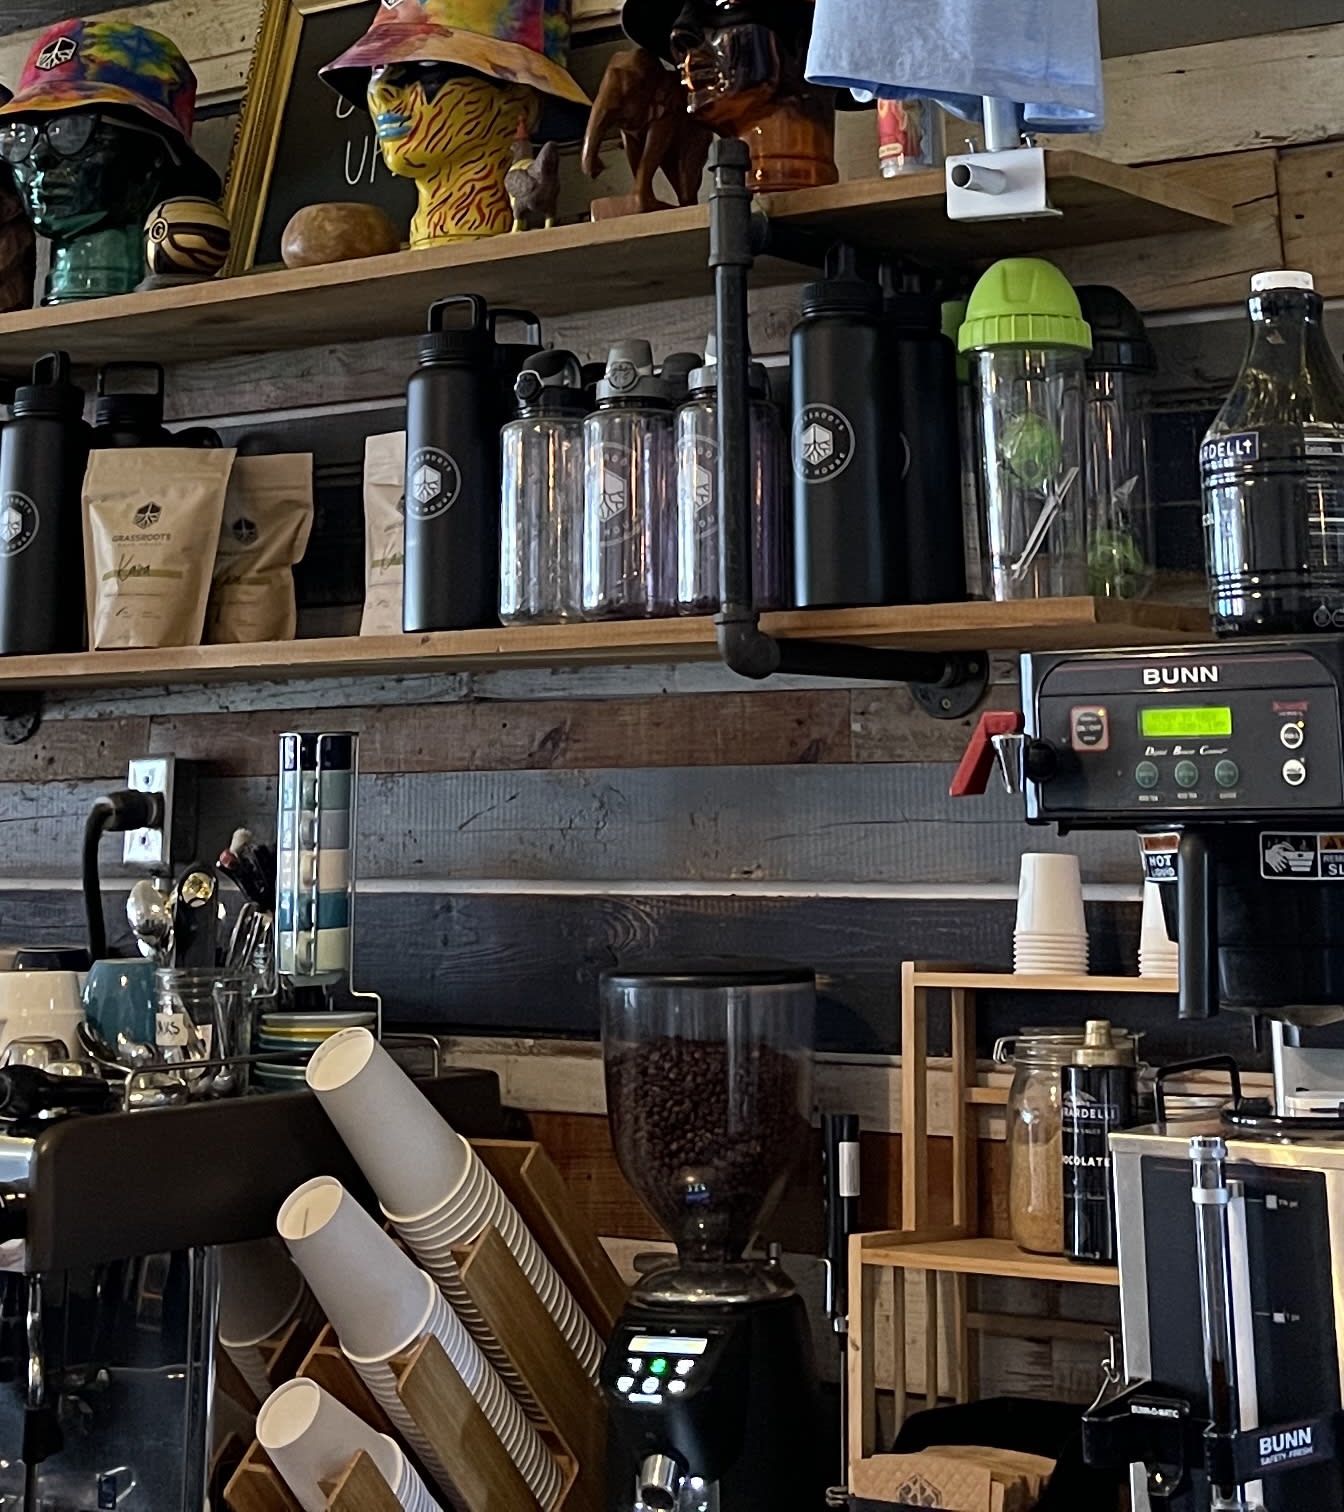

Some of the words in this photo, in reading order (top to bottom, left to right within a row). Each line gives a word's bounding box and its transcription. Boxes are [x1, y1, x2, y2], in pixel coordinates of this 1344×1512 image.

[1143, 665, 1219, 685] BUNN
[1148, 854, 1172, 867] HOT
[1063, 1155, 1111, 1167] OCOLATE
[1259, 1426, 1312, 1456] BUNN
